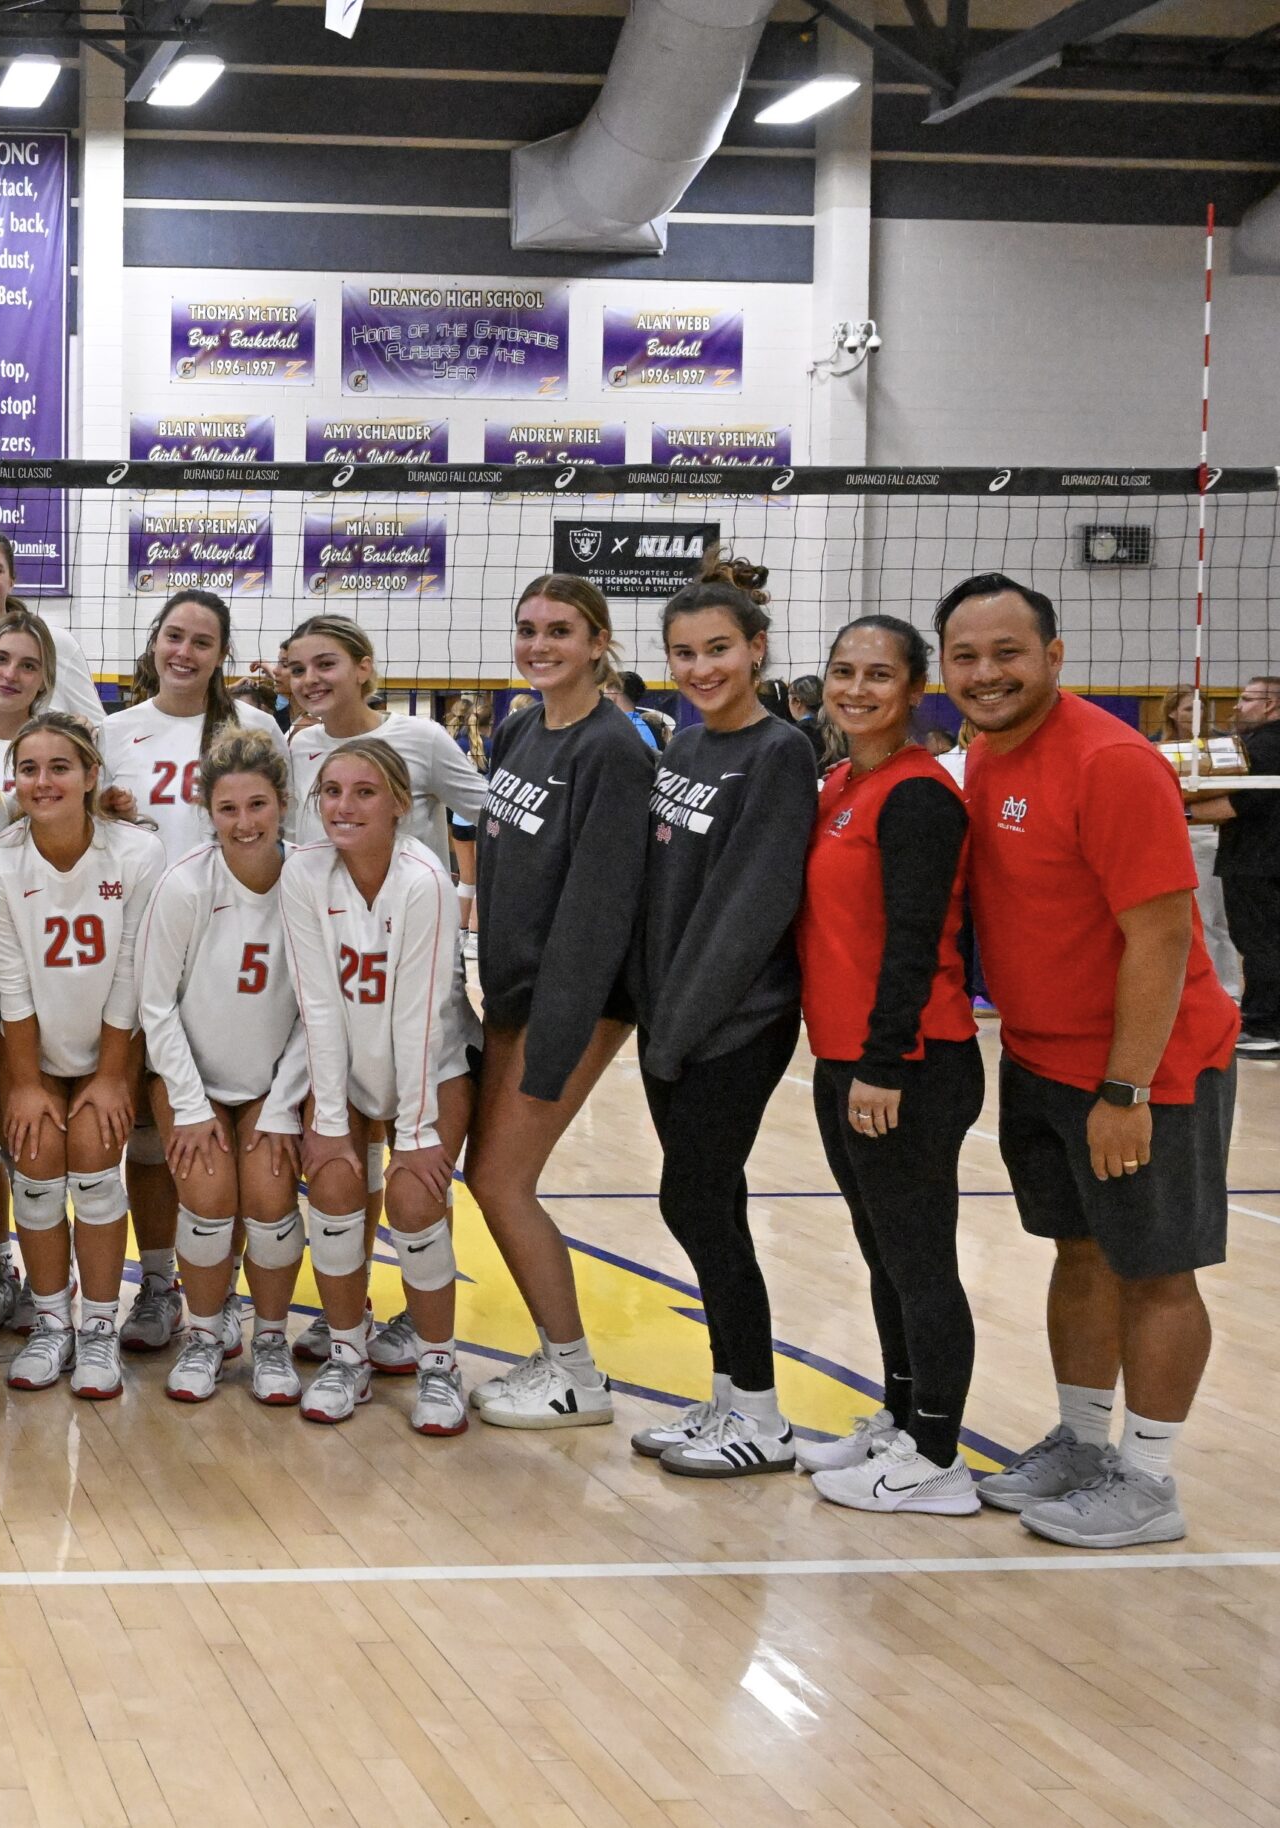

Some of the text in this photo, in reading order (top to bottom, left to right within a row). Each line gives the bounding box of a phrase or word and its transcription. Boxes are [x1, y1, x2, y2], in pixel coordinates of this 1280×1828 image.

[10, 212, 50, 237] back,
[370, 289, 544, 308] DURANGO HIGH SCHOOL
[188, 304, 297, 322] THOMAS McTYER
[637, 315, 710, 331] ALAN WEBB
[188, 328, 298, 350] Boys' Basketball
[647, 339, 702, 357] Baseball
[0, 360, 30, 383] top,
[209, 360, 276, 376] 1996-1997
[640, 369, 705, 384] 1996-1997
[0, 395, 36, 420] stop!
[159, 421, 246, 438] BLAIR WILKES
[324, 424, 431, 440] AMY SCHLAUDER
[509, 426, 601, 444] ANDREW FRIEL
[668, 430, 776, 447] HAYLEY SPELMAN
[184, 469, 279, 480] DURANGO FALL CLASSIC
[628, 472, 721, 484] DURANGO FALL CLASSIC
[1062, 474, 1150, 486] DURANGO FALL CLASSIC
[145, 518, 257, 534] HAYLEY SPELMAN
[346, 521, 404, 537] MIA BELL
[147, 542, 255, 566] Girls' Volleyball
[321, 545, 431, 567] Girls' Basketball
[635, 535, 704, 559] NIAA
[167, 572, 233, 588] 2008-2009
[341, 575, 407, 590] 2008-2009
[605, 577, 642, 585] SCHOOL
[149, 760, 201, 805] 26
[43, 914, 106, 969] 29
[237, 942, 270, 995] 5
[340, 942, 388, 1005] 25
